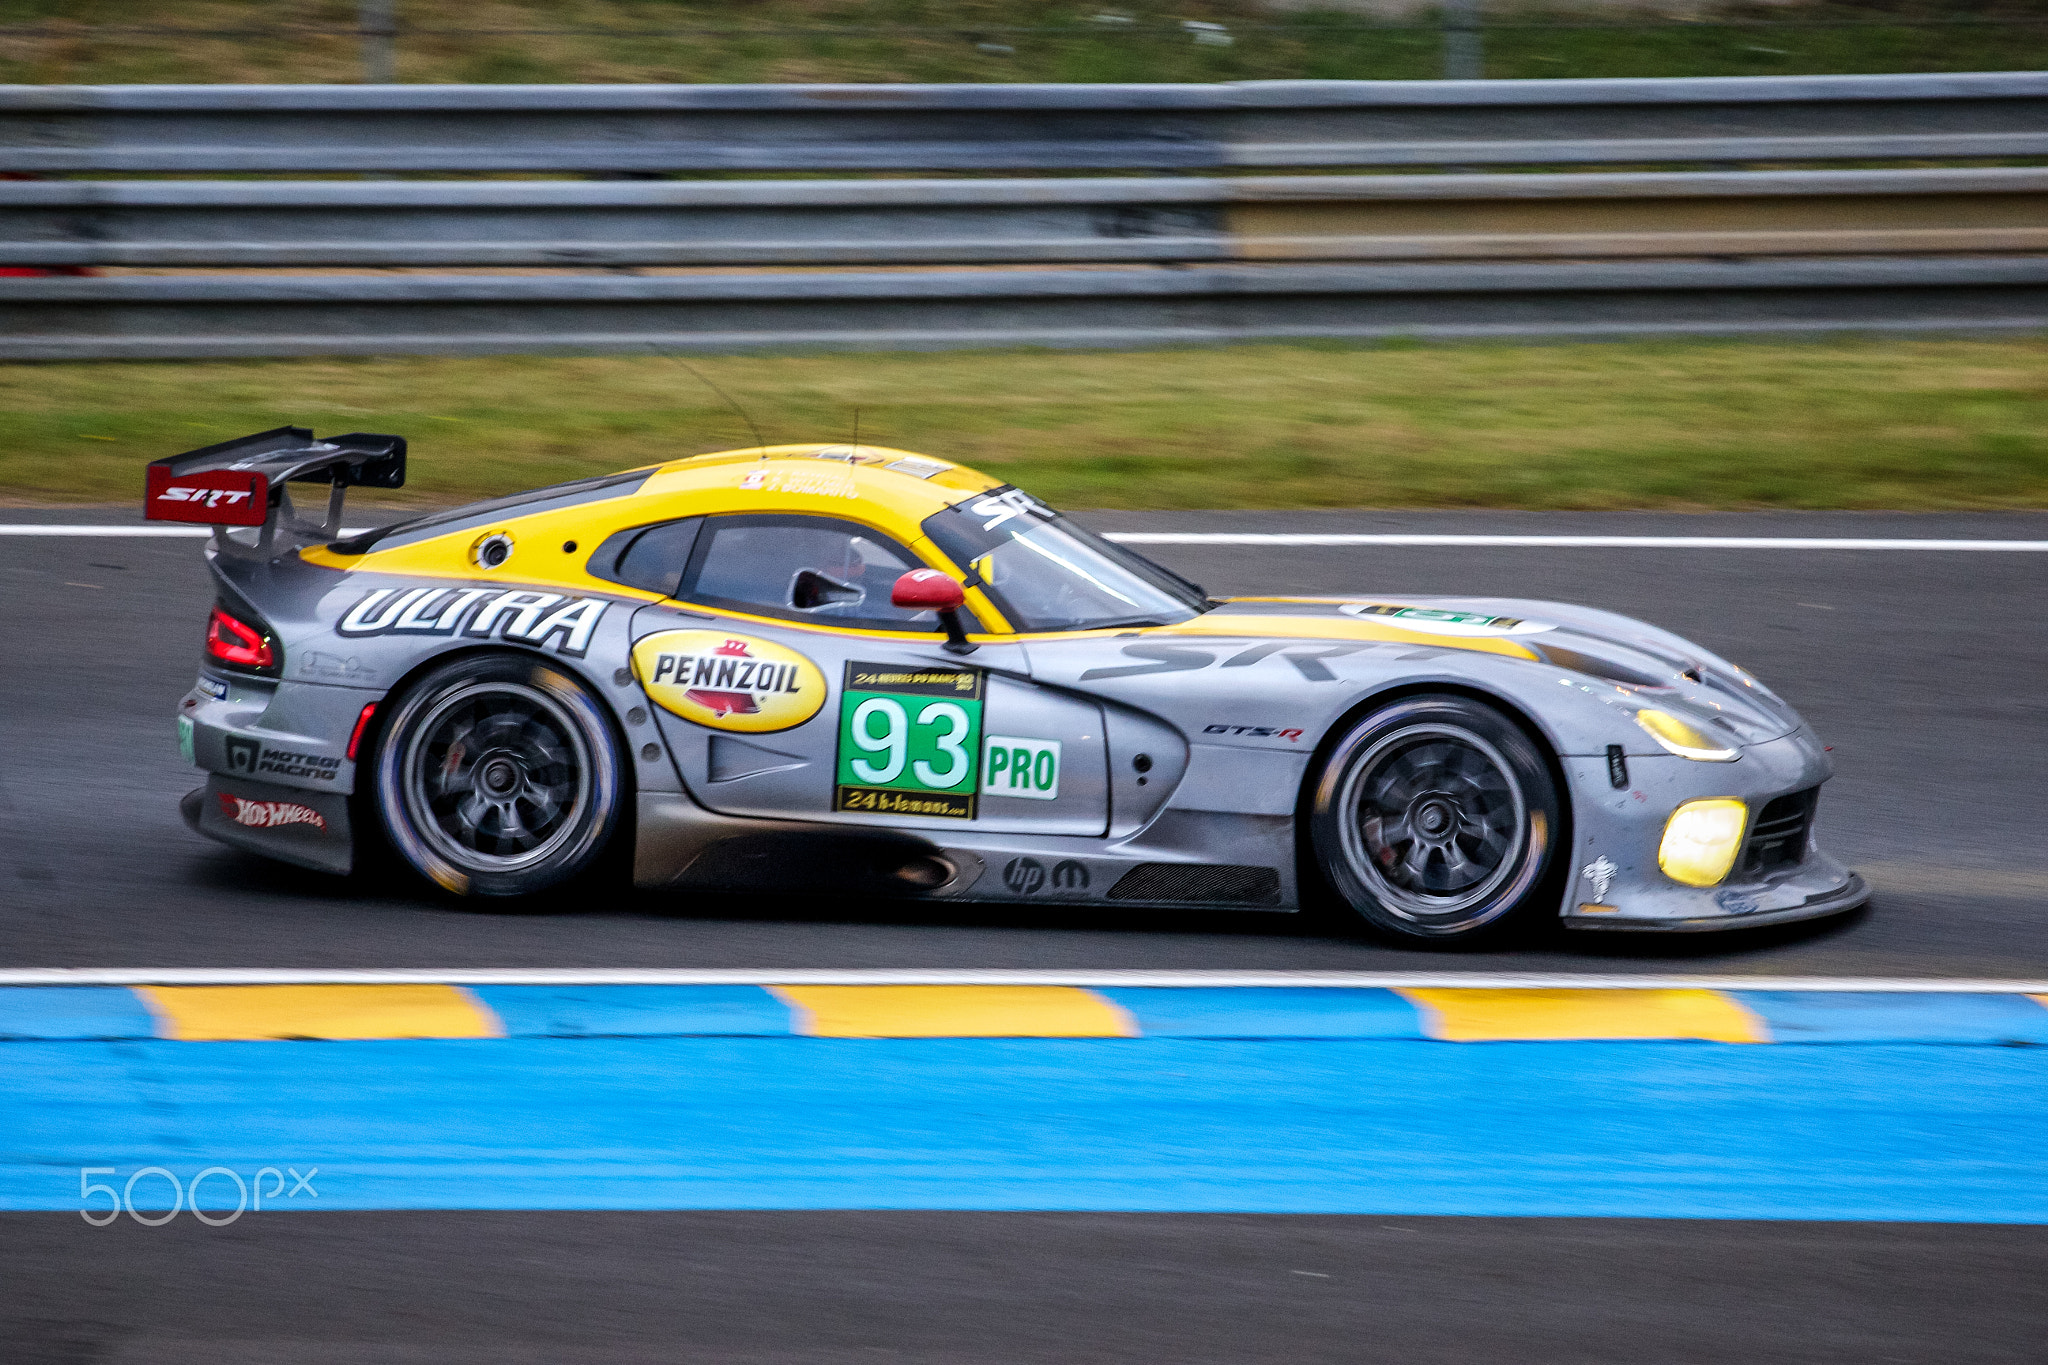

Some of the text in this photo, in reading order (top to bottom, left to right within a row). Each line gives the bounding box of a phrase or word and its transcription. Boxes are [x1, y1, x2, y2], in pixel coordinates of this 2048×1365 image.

[157, 486, 252, 508] SRT
[338, 587, 613, 656] ULTRA
[652, 655, 802, 693] PENNZOIL
[850, 697, 970, 789] 93
[1202, 724, 1305, 742] GTS-R
[259, 761, 337, 780] RACING
[262, 749, 341, 769] MOTEGI
[987, 746, 1055, 791] PRO
[1010, 857, 1042, 894] hp
